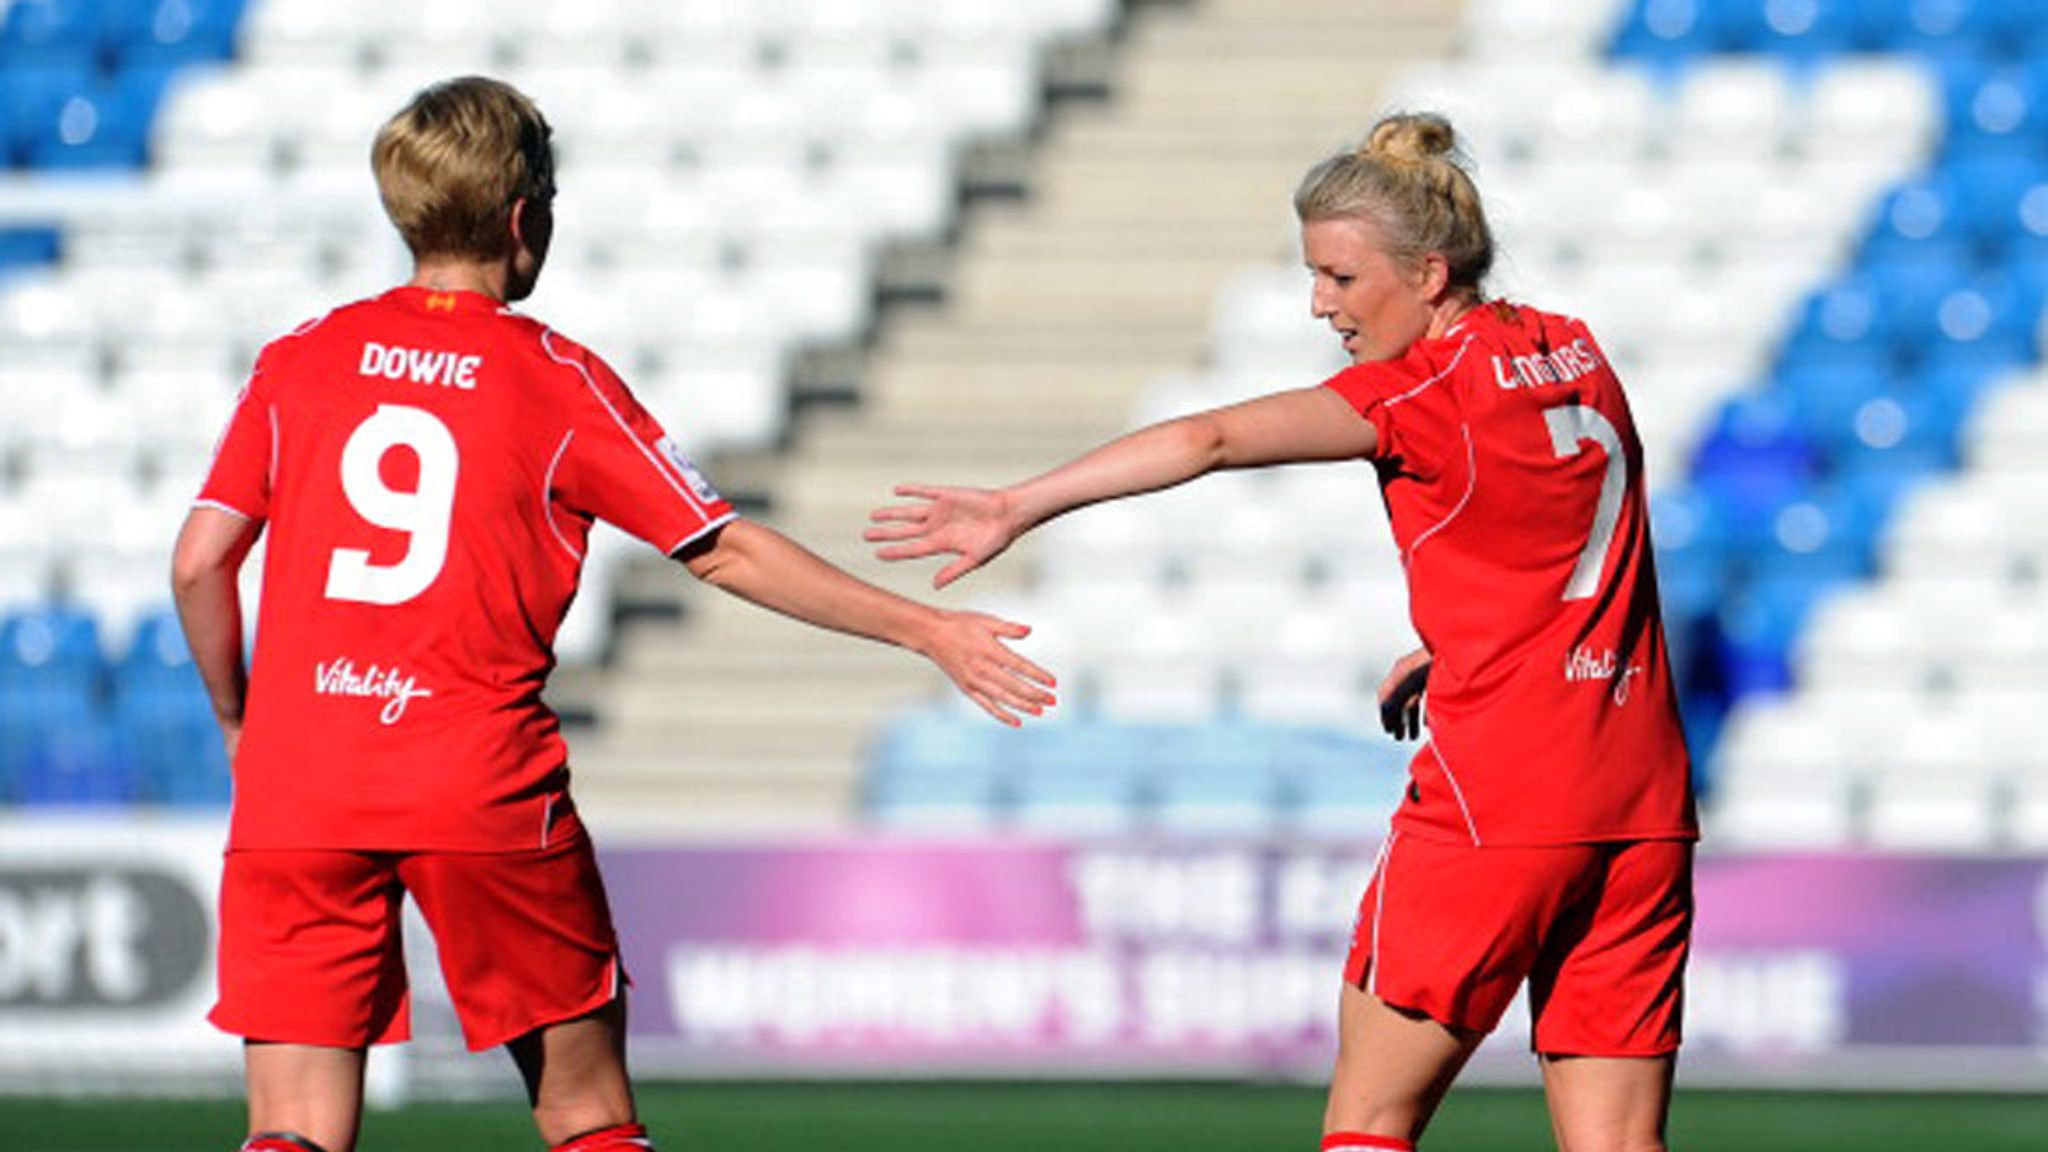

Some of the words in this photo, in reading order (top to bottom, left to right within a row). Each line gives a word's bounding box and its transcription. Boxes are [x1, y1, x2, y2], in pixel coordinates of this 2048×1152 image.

[359, 341, 482, 390] DOWIE
[324, 403, 460, 606] 9
[1543, 404, 1628, 601] 7
[314, 657, 433, 725] Vitality
[668, 946, 1124, 1046] WOMEN'S
